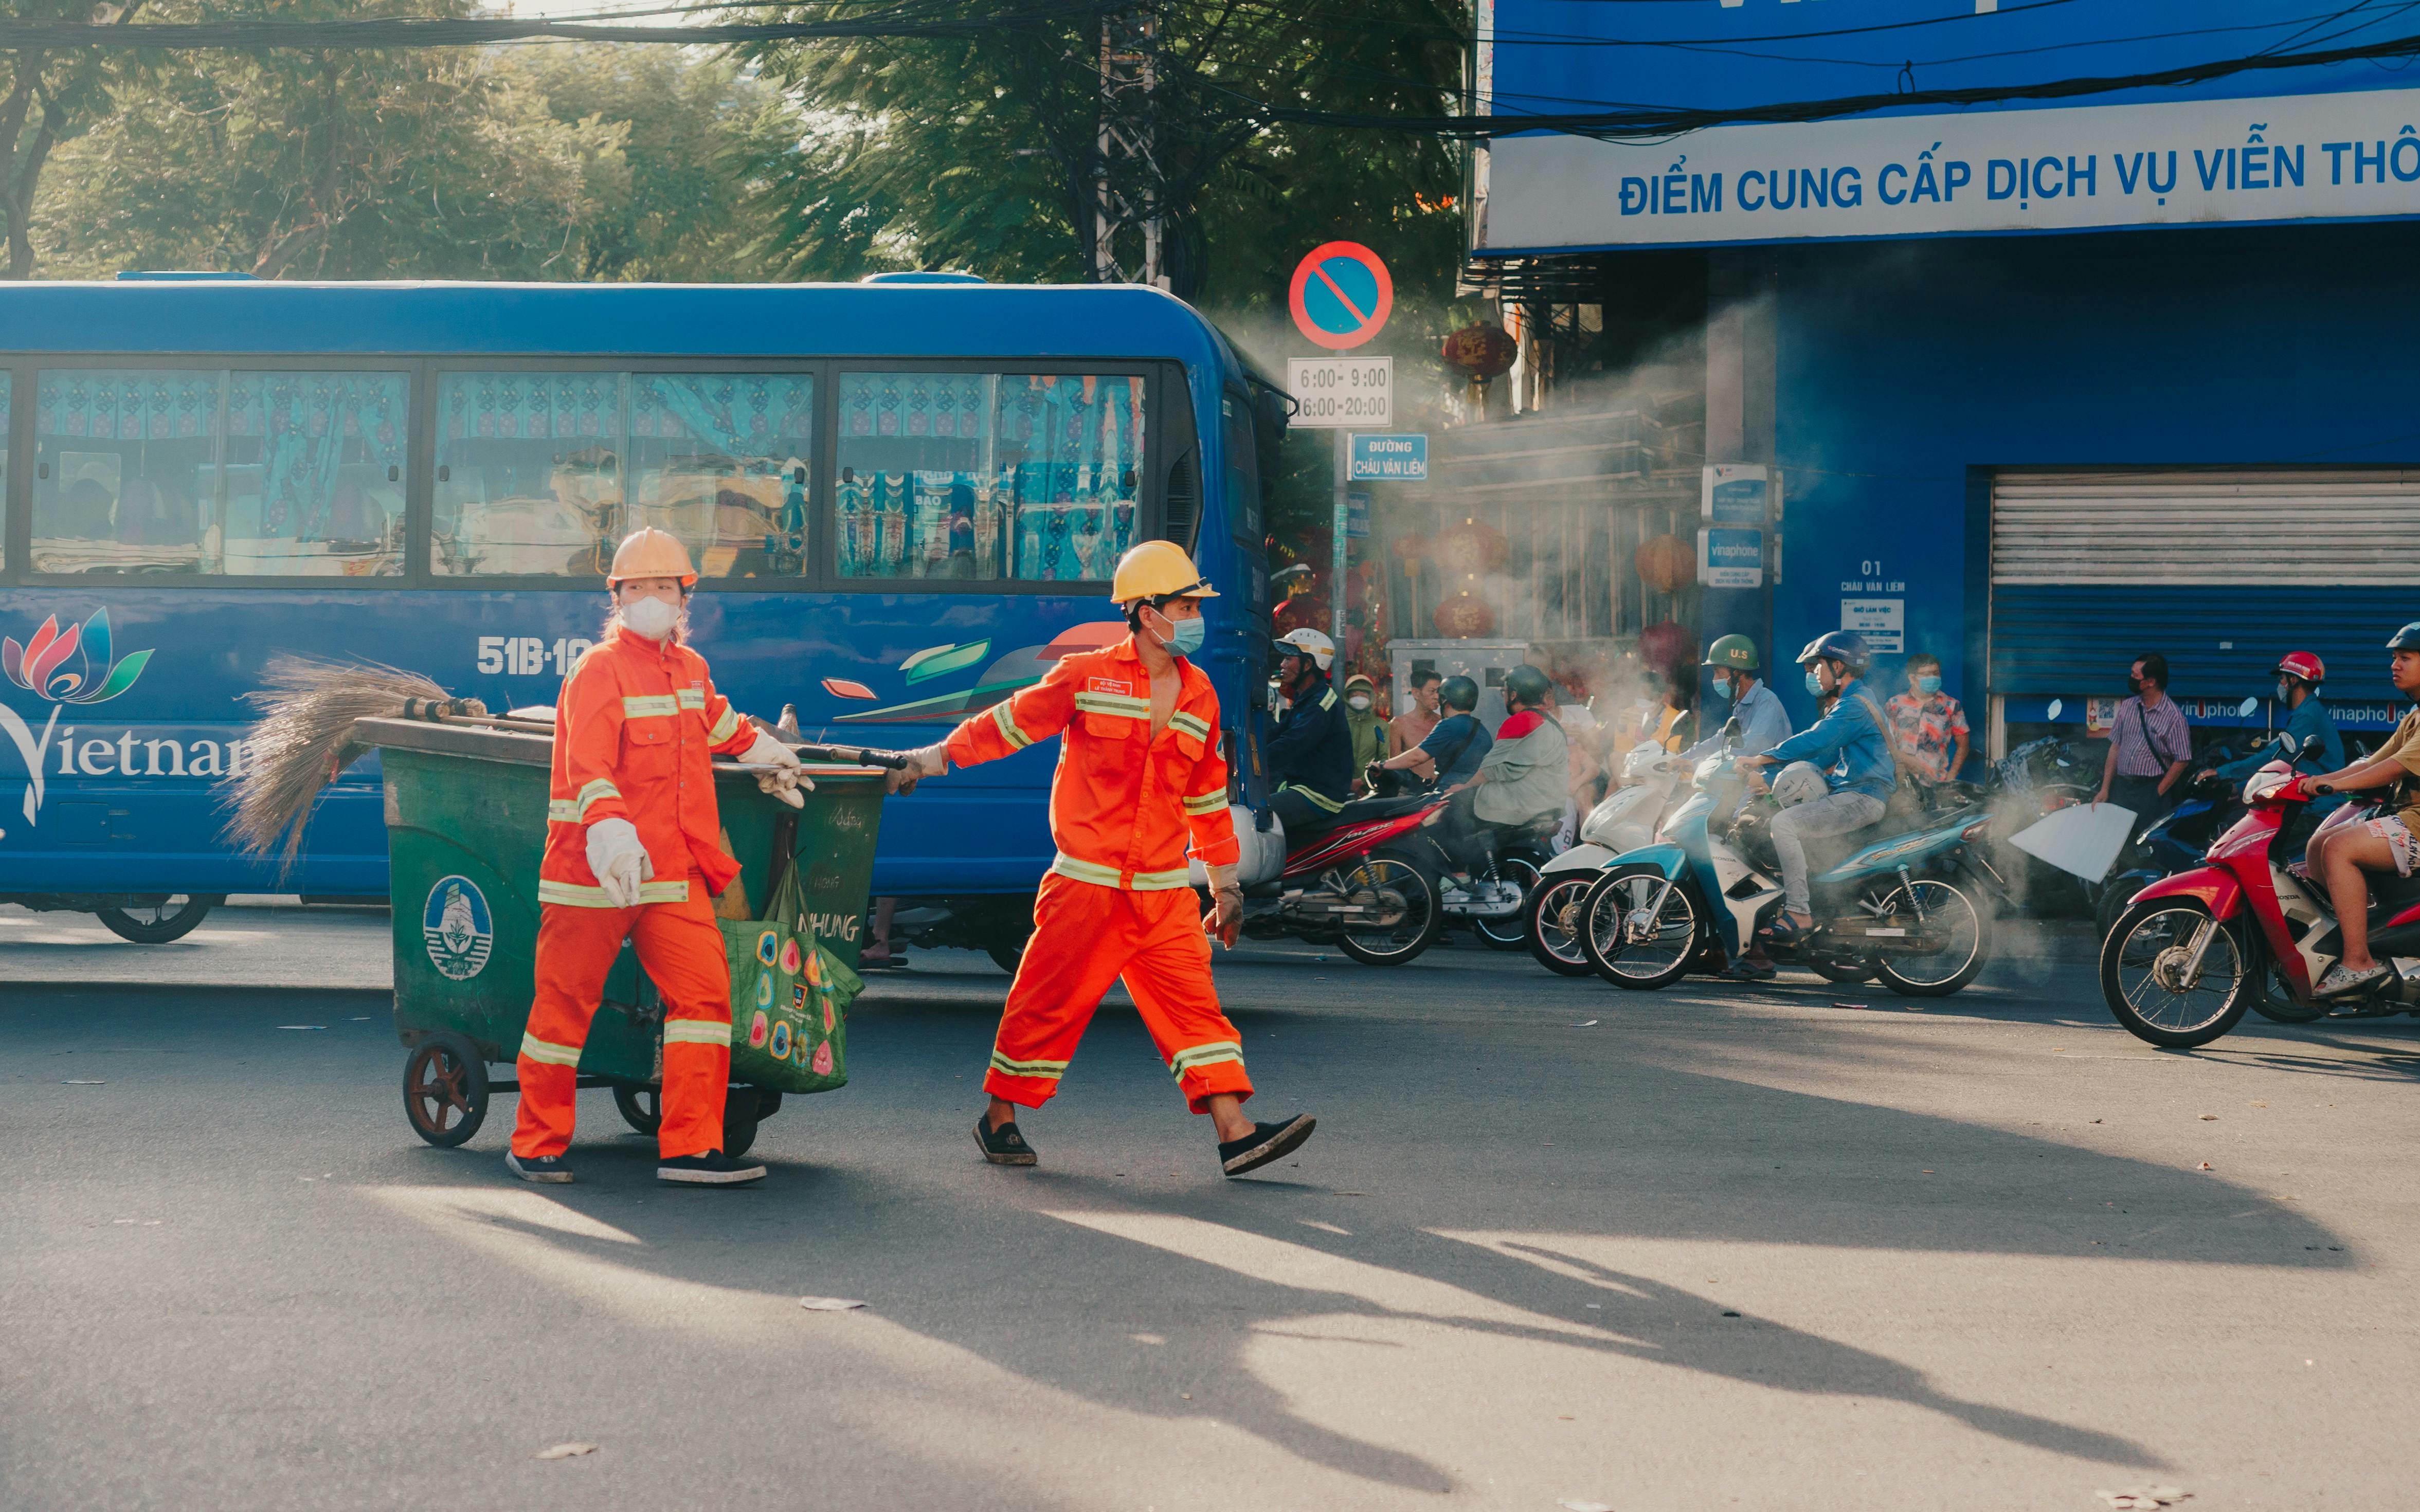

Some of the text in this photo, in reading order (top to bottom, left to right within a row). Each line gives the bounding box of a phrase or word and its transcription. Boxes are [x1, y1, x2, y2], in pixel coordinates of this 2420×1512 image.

[1619, 155, 1722, 216] ĐIỂM
[1737, 167, 1862, 211] CUNG
[1878, 141, 1971, 205] CẤP
[1988, 155, 2097, 209] DỊCH
[2114, 151, 2177, 206] VỤ
[2194, 123, 2304, 191] VIỄN
[1369, 439, 1413, 452] ĐƯỜNG
[1356, 457, 1425, 475] CHÂU VĂN LIÊM
[1711, 543, 1758, 558] vinaphone
[1862, 560, 1881, 576] 01
[1841, 579, 1863, 592] CHÂU
[1866, 579, 1882, 592] VĂN
[2328, 704, 2407, 723] inaphoe
[2409, 833, 2418, 855] ELAY
[798, 913, 860, 942] NHUNG
